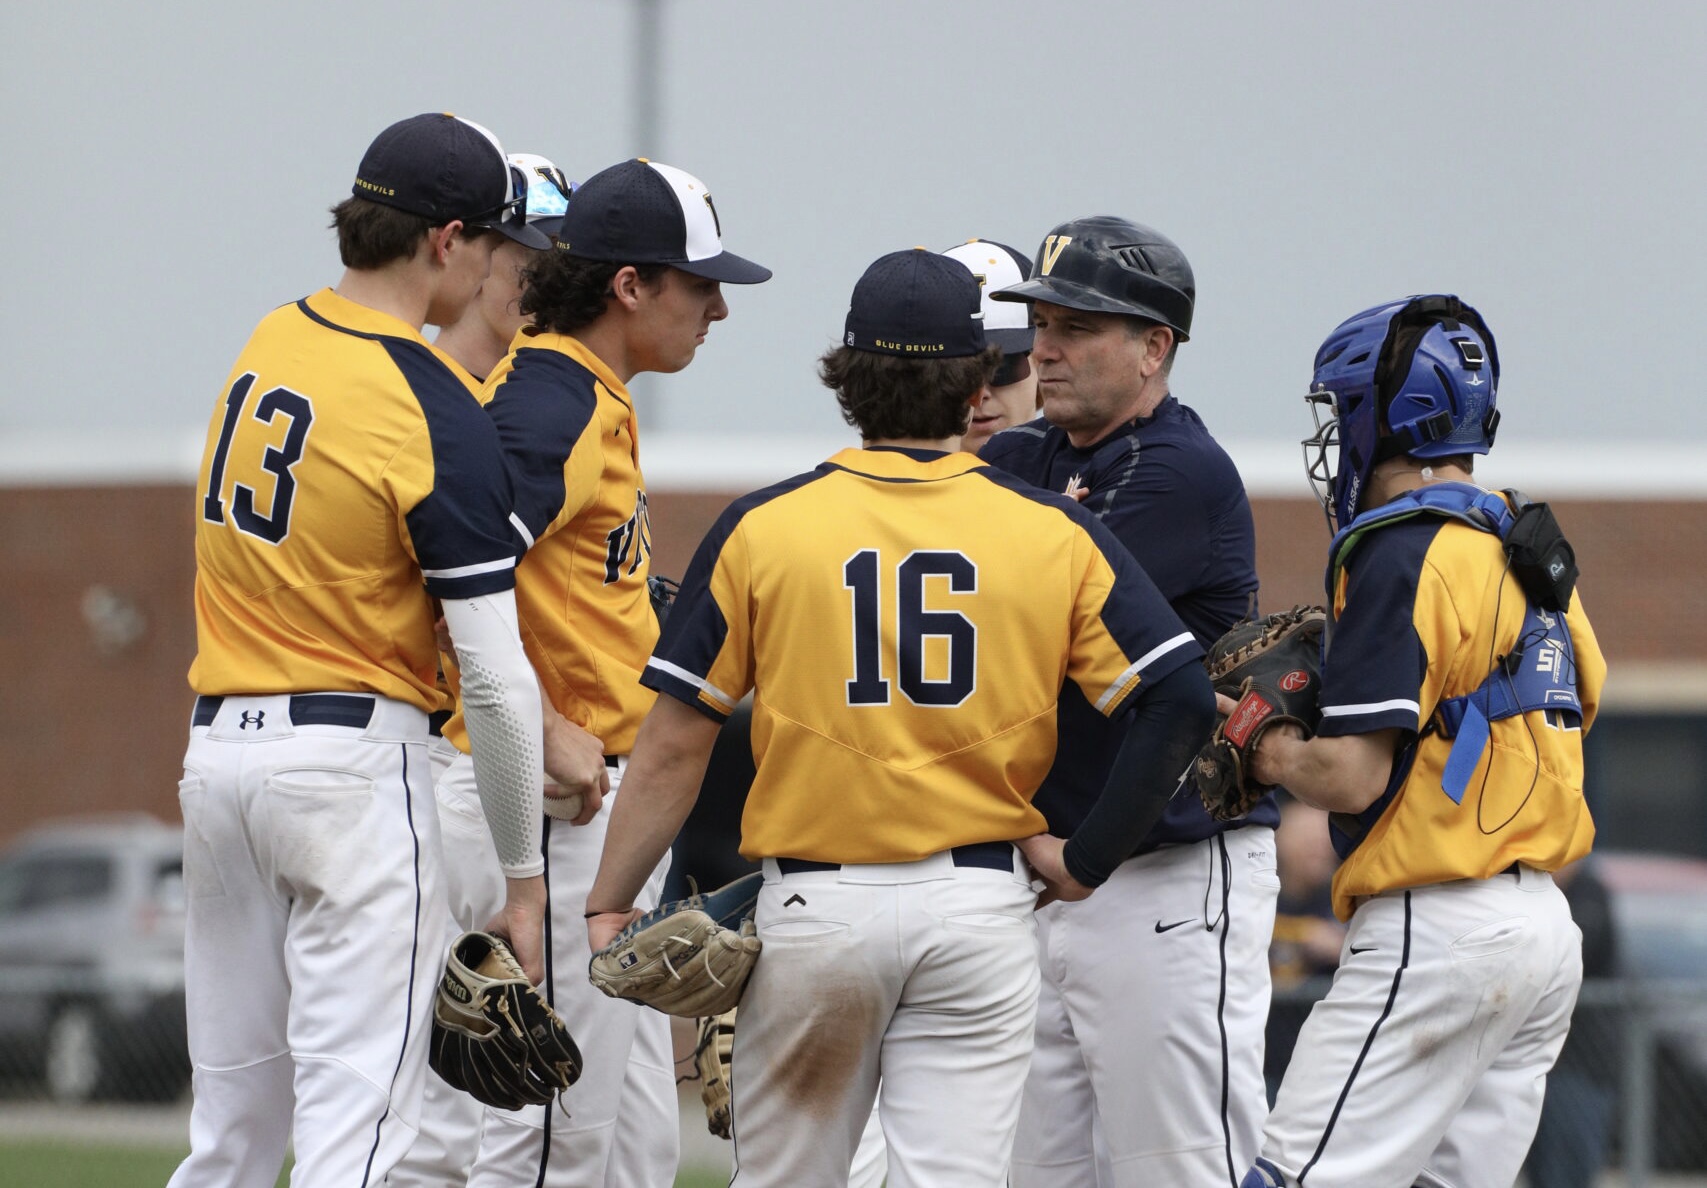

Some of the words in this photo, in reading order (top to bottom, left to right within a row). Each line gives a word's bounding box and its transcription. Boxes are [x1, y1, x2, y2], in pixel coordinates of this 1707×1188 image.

[362, 181, 395, 196] DEVILS
[1041, 235, 1073, 276] V
[875, 339, 901, 350] BLUE
[905, 344, 945, 352] DEVILS
[203, 370, 316, 547] 13
[843, 548, 979, 708] 16
